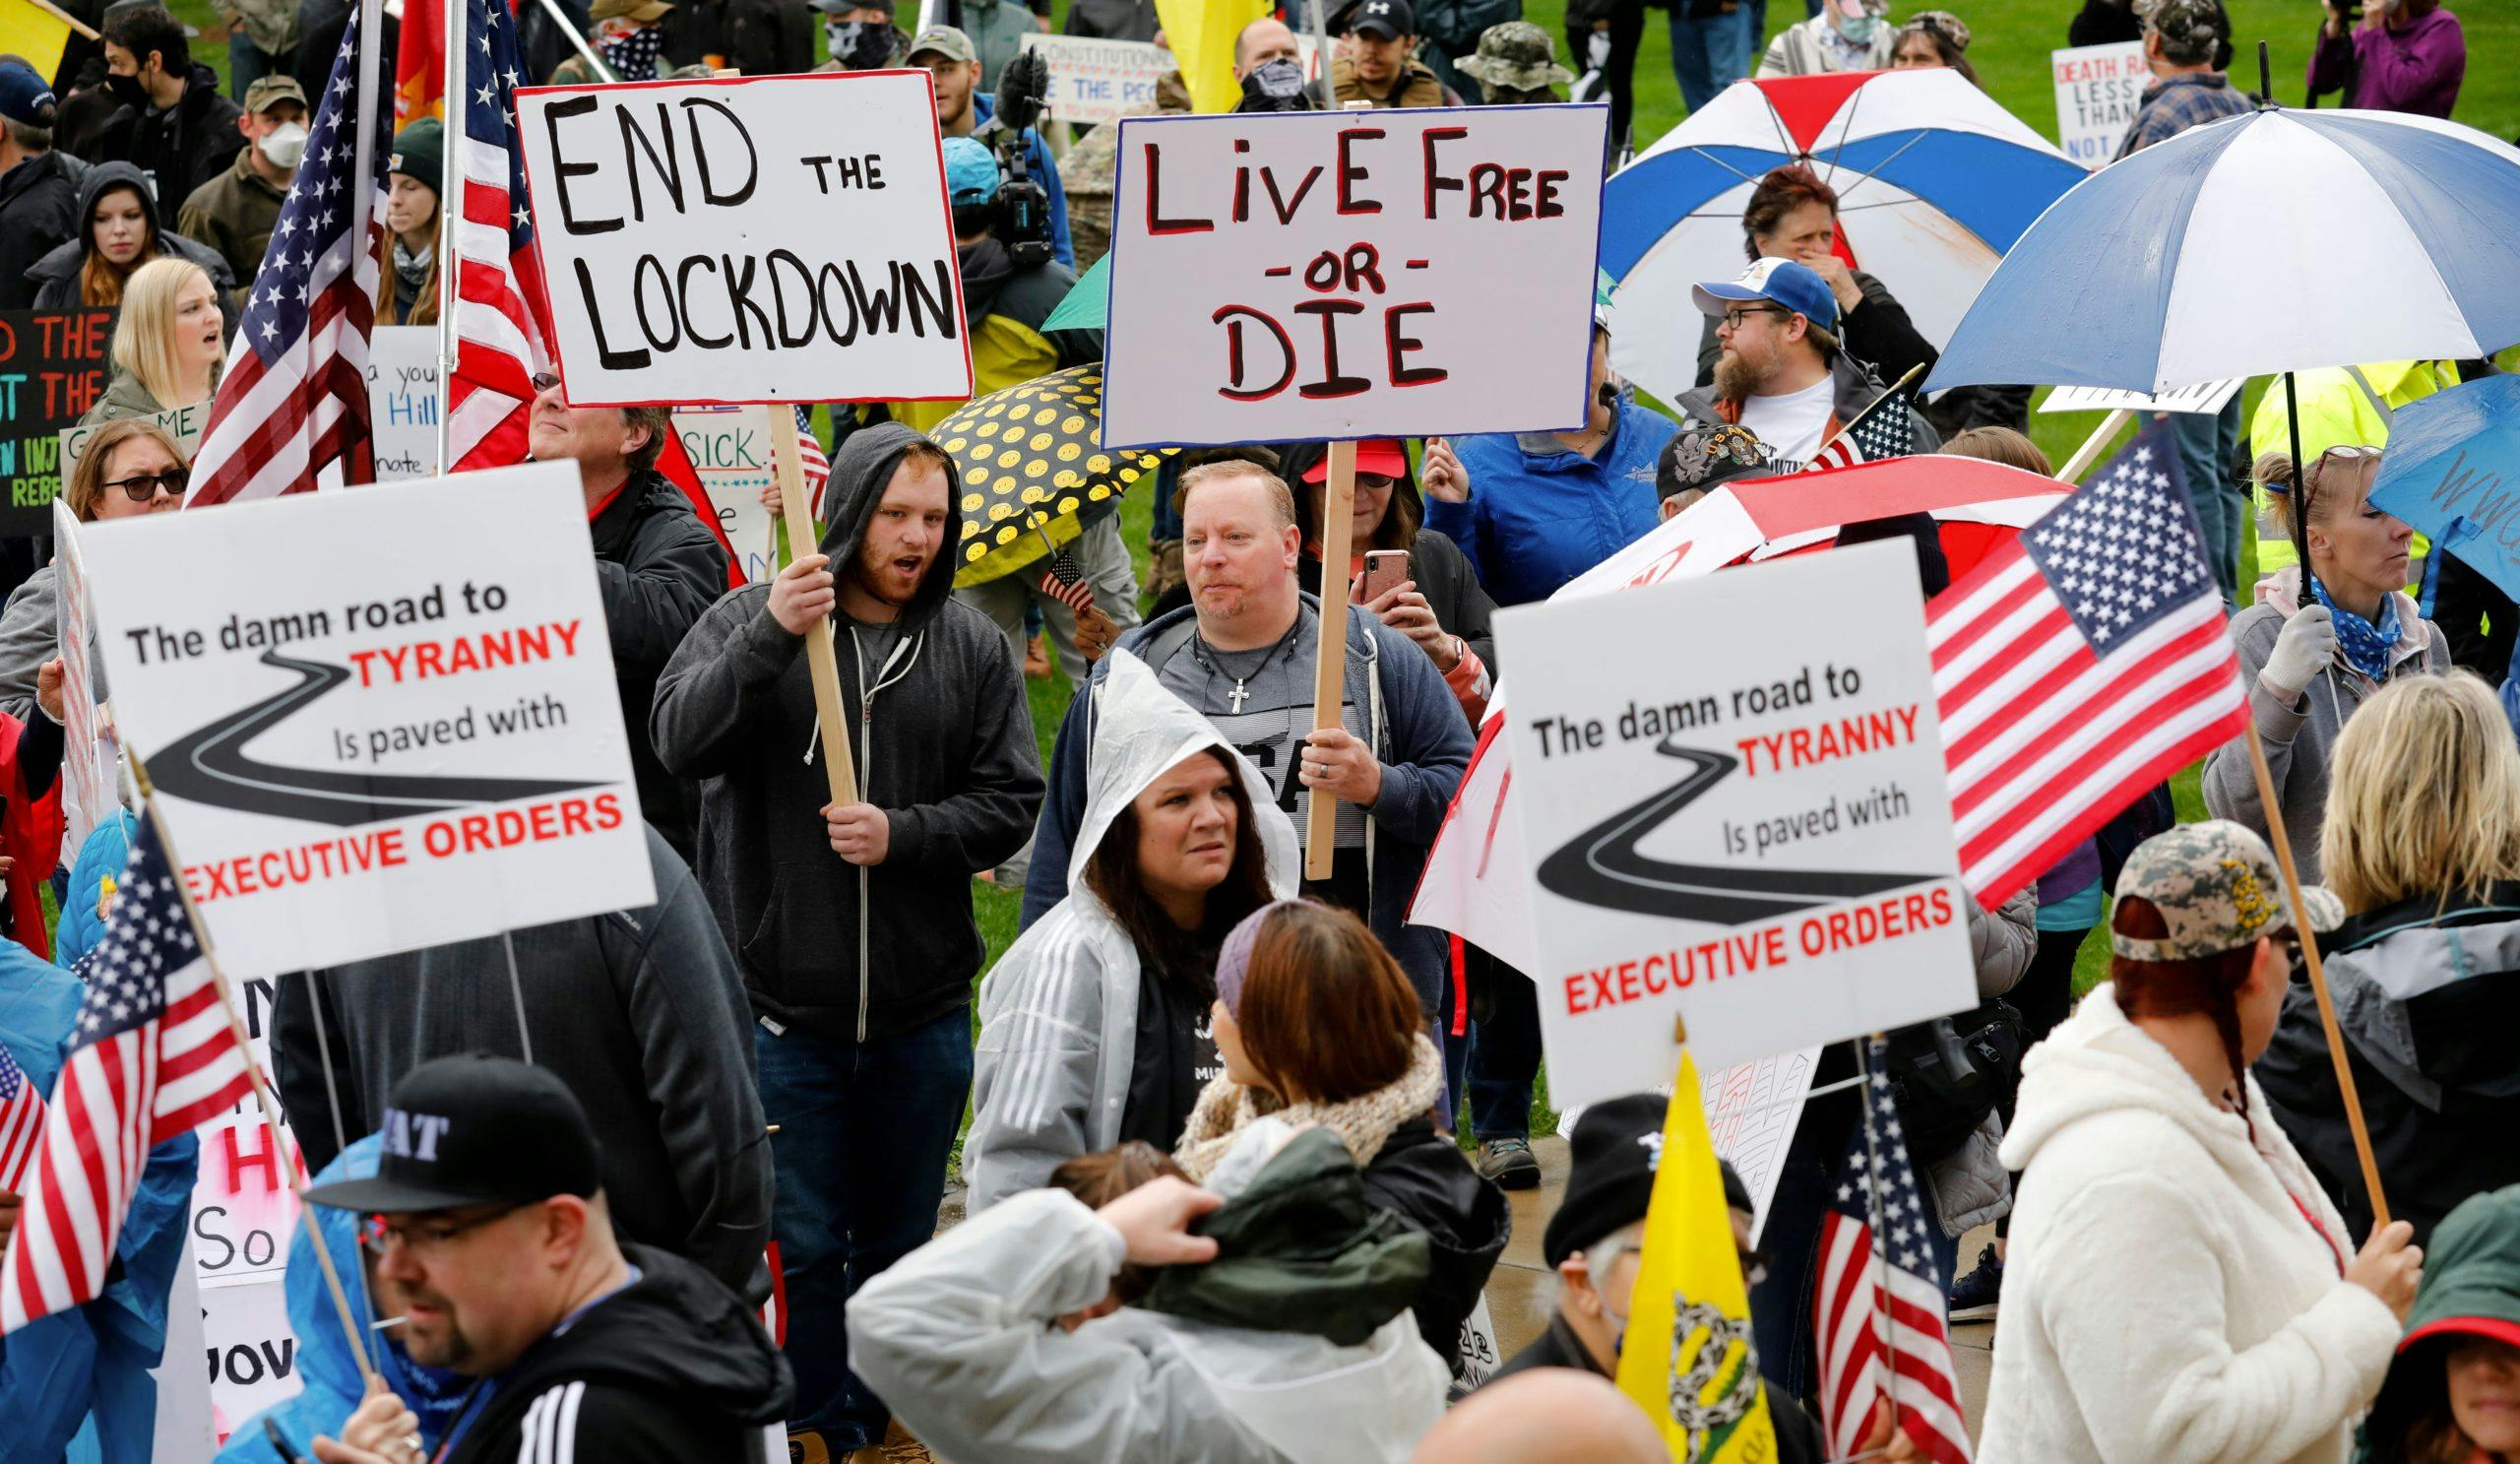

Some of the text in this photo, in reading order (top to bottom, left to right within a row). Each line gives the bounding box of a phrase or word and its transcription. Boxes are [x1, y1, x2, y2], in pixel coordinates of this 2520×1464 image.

[1074, 79, 1113, 99] THE
[2056, 57, 2117, 85] DEATH
[2074, 79, 2134, 104] LESS
[2068, 135, 2110, 159] NOT
[2077, 102, 2137, 128] THAN
[544, 95, 887, 235] END THE
[33, 313, 110, 360] THE
[573, 249, 957, 370] LOCKDOWN
[1212, 298, 1449, 403] DIE
[39, 370, 102, 420] THE
[158, 407, 198, 438] ME
[126, 580, 509, 666] The damn road to
[349, 619, 582, 688] TYRANNY
[333, 693, 568, 764] Is paved with
[1533, 664, 1862, 759] The damn road to
[1736, 703, 1920, 780] TYRANNY
[181, 794, 624, 905] EXECUTIVE ORDERS
[1725, 783, 1911, 859] Is paved with
[1563, 887, 1953, 1017] EXECUTIVE ORDERS
[194, 1206, 276, 1270] So
